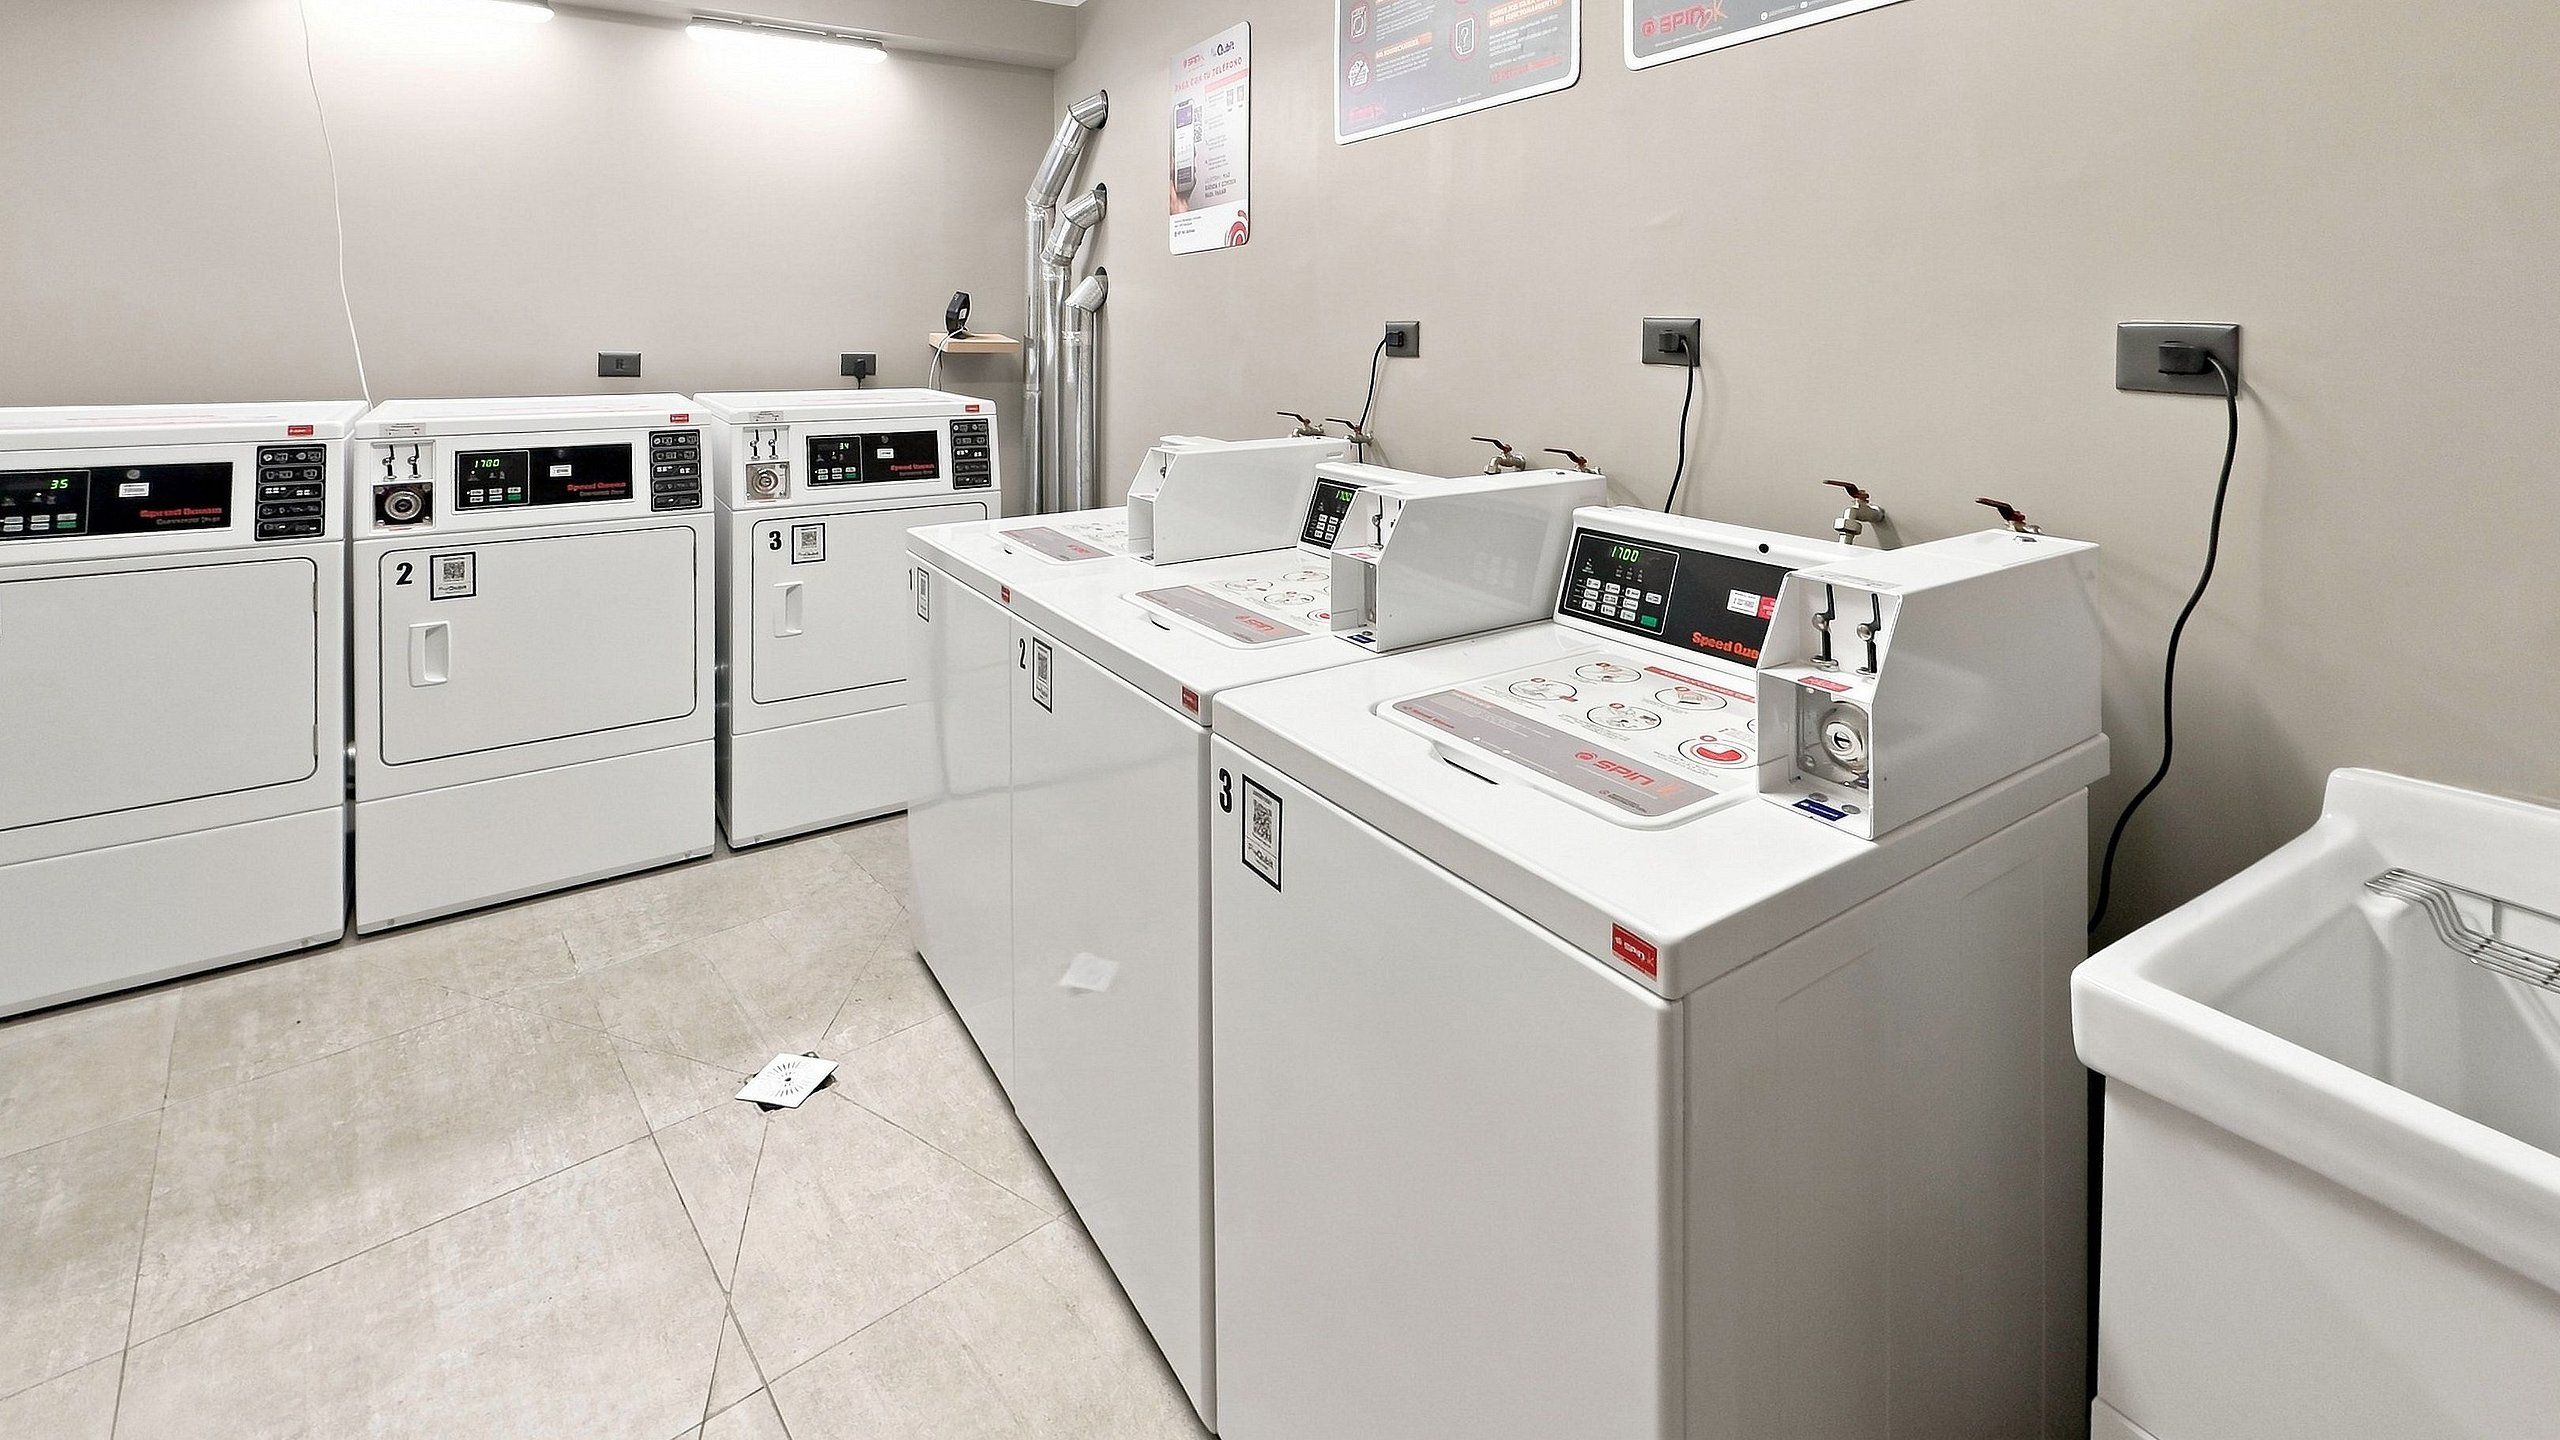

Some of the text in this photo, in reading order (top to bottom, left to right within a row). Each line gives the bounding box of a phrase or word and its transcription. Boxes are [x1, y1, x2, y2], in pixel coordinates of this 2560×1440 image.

[50, 478, 69, 490] 35
[769, 530, 782, 551] 3
[1611, 545, 1640, 563] 1700
[396, 561, 413, 586] 2
[908, 568, 913, 591] 1
[1019, 637, 1027, 670] 2
[1691, 630, 1760, 660] Speed Que
[1592, 759, 1655, 786] SPIN
[1218, 767, 1233, 814] 3
